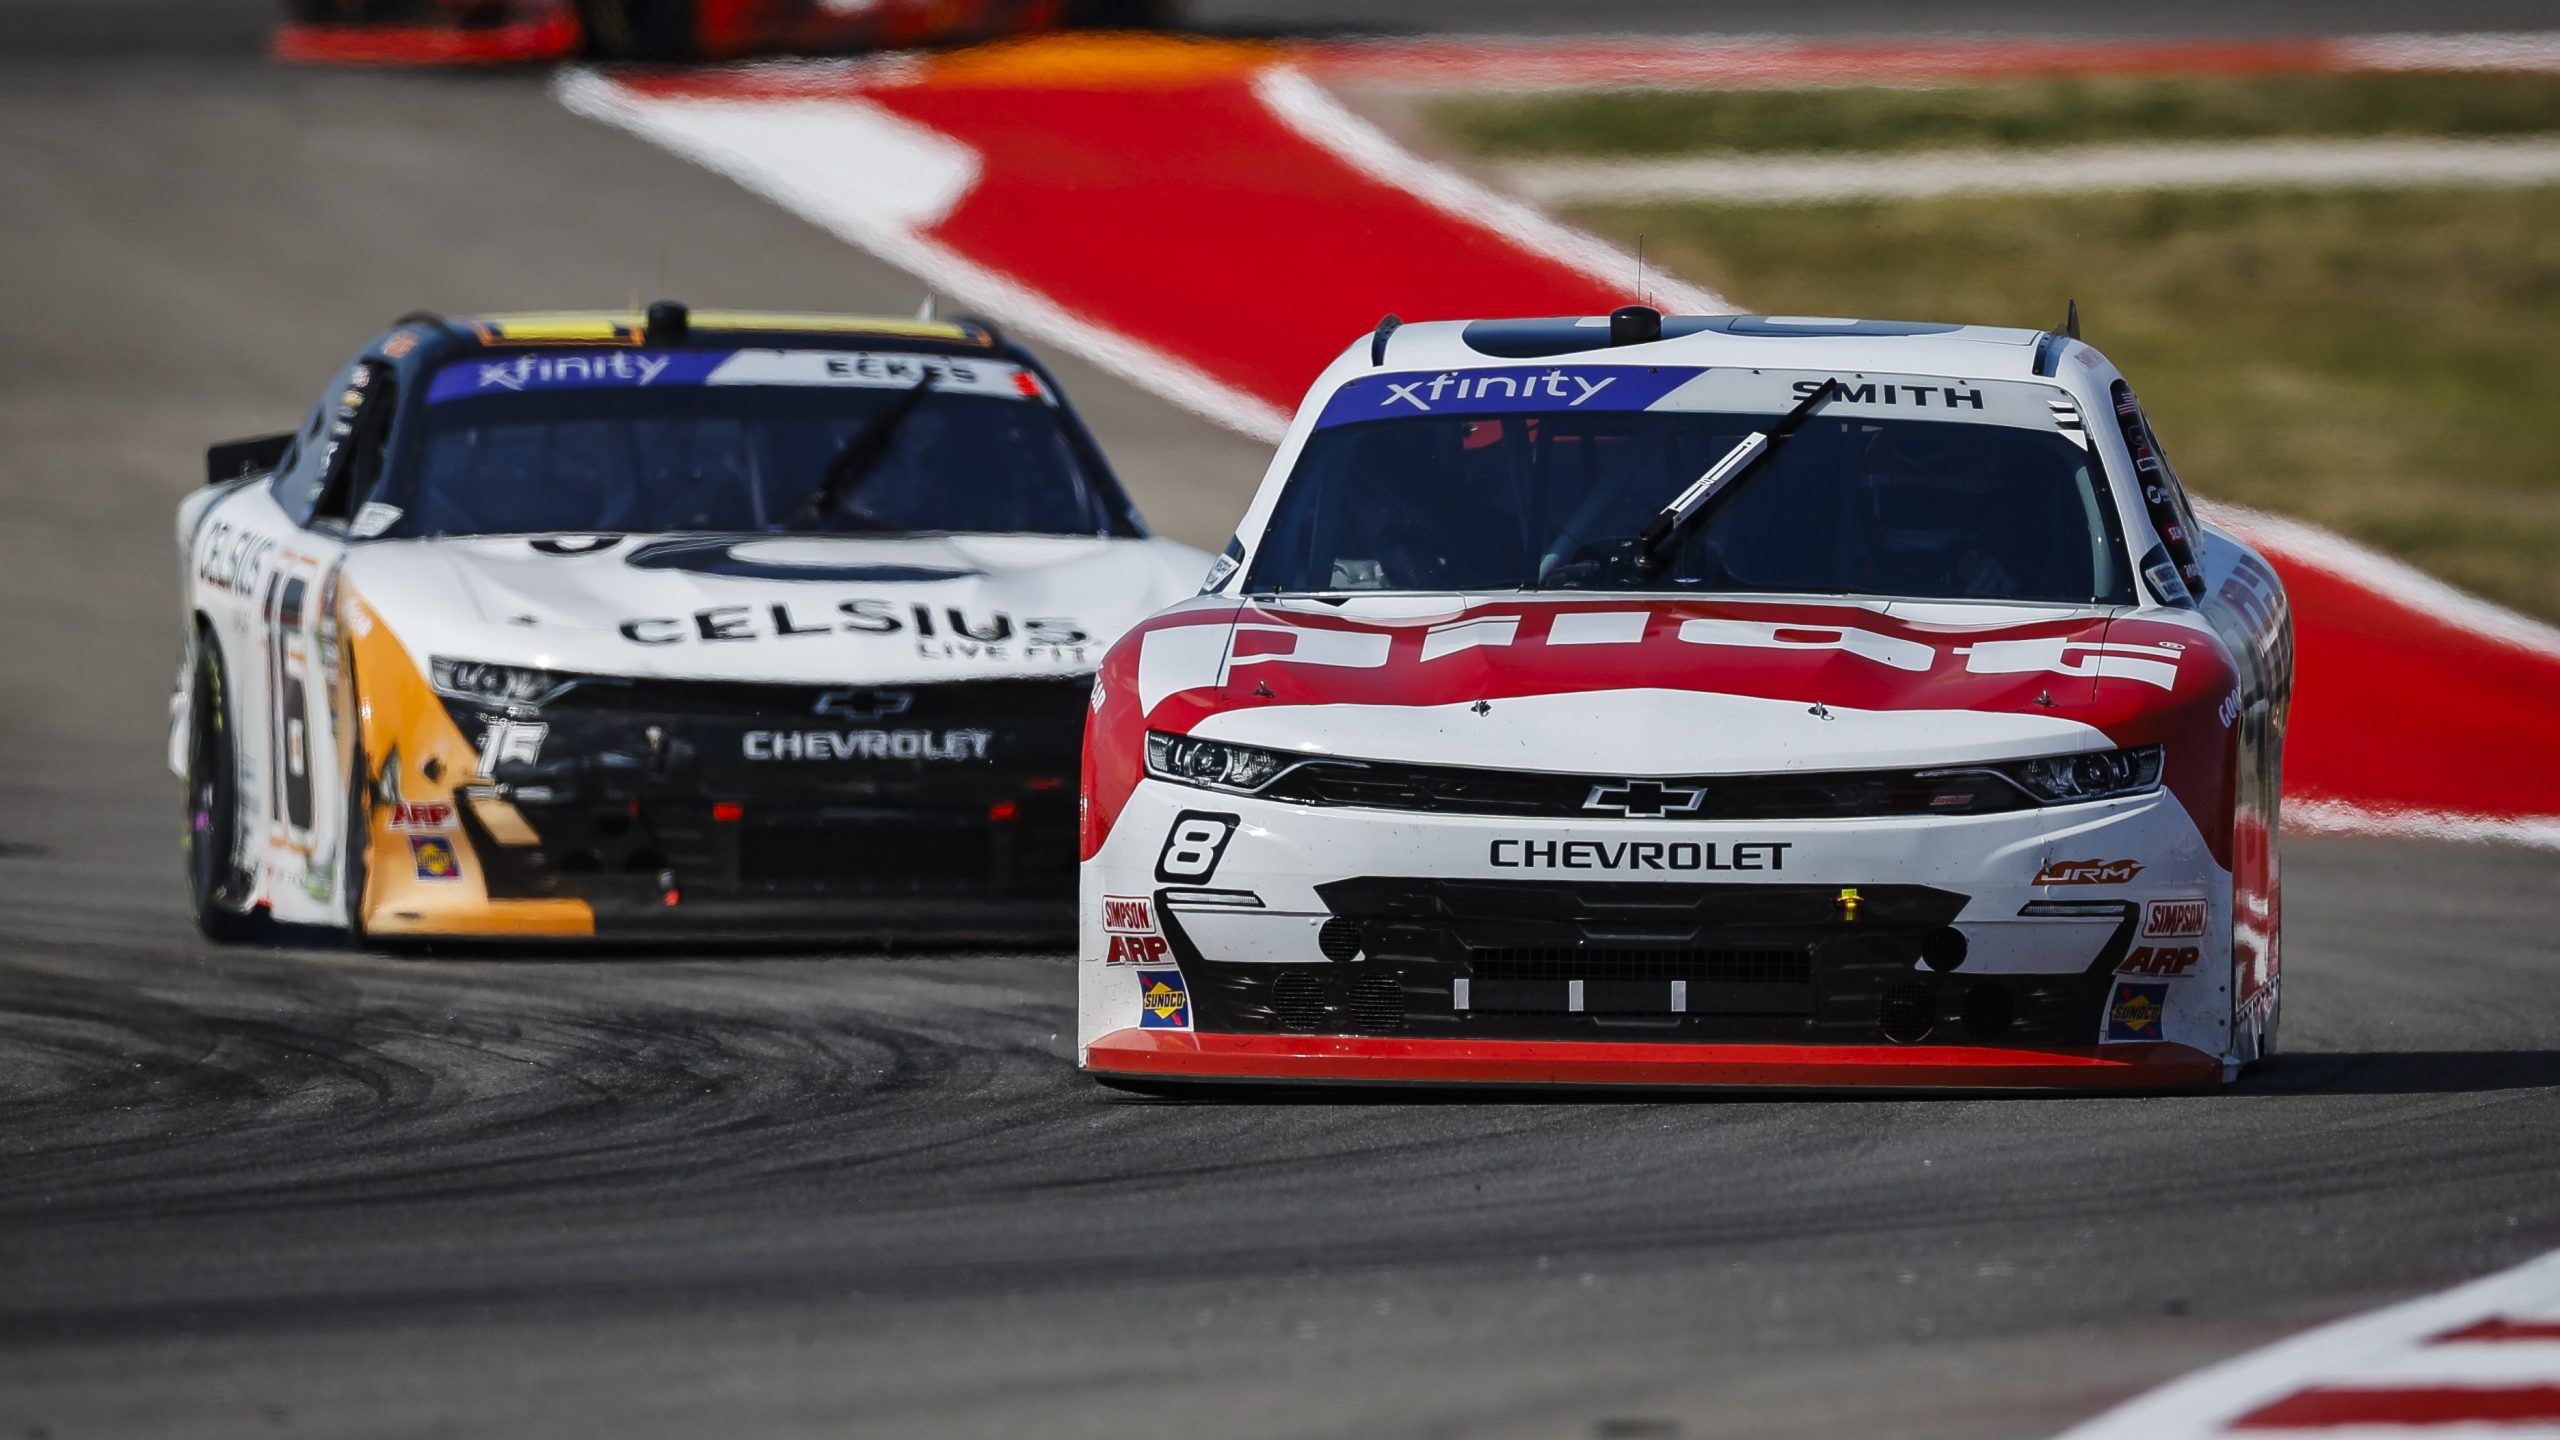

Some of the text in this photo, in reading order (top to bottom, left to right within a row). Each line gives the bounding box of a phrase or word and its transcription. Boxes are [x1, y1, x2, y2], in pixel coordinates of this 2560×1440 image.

[479, 352, 669, 391] xfinity
[1380, 369, 1618, 411] xfinity
[1792, 380, 1985, 410] SMITH
[619, 600, 1088, 645] CELSIUS
[918, 641, 1086, 664] LIVE FIT
[743, 727, 992, 761] CHEVROLET
[1161, 817, 1229, 877] 8
[1490, 840, 1793, 871] CHEVROLET
[2041, 868, 2131, 884] JRM
[1105, 901, 1150, 929] SIMPSON
[2148, 903, 2205, 933] SIMPSON
[1107, 935, 1168, 963] ARP
[2117, 946, 2200, 974] ARP
[1145, 994, 1184, 1008] SUNOCO
[2114, 1005, 2160, 1020] SUNOCO
